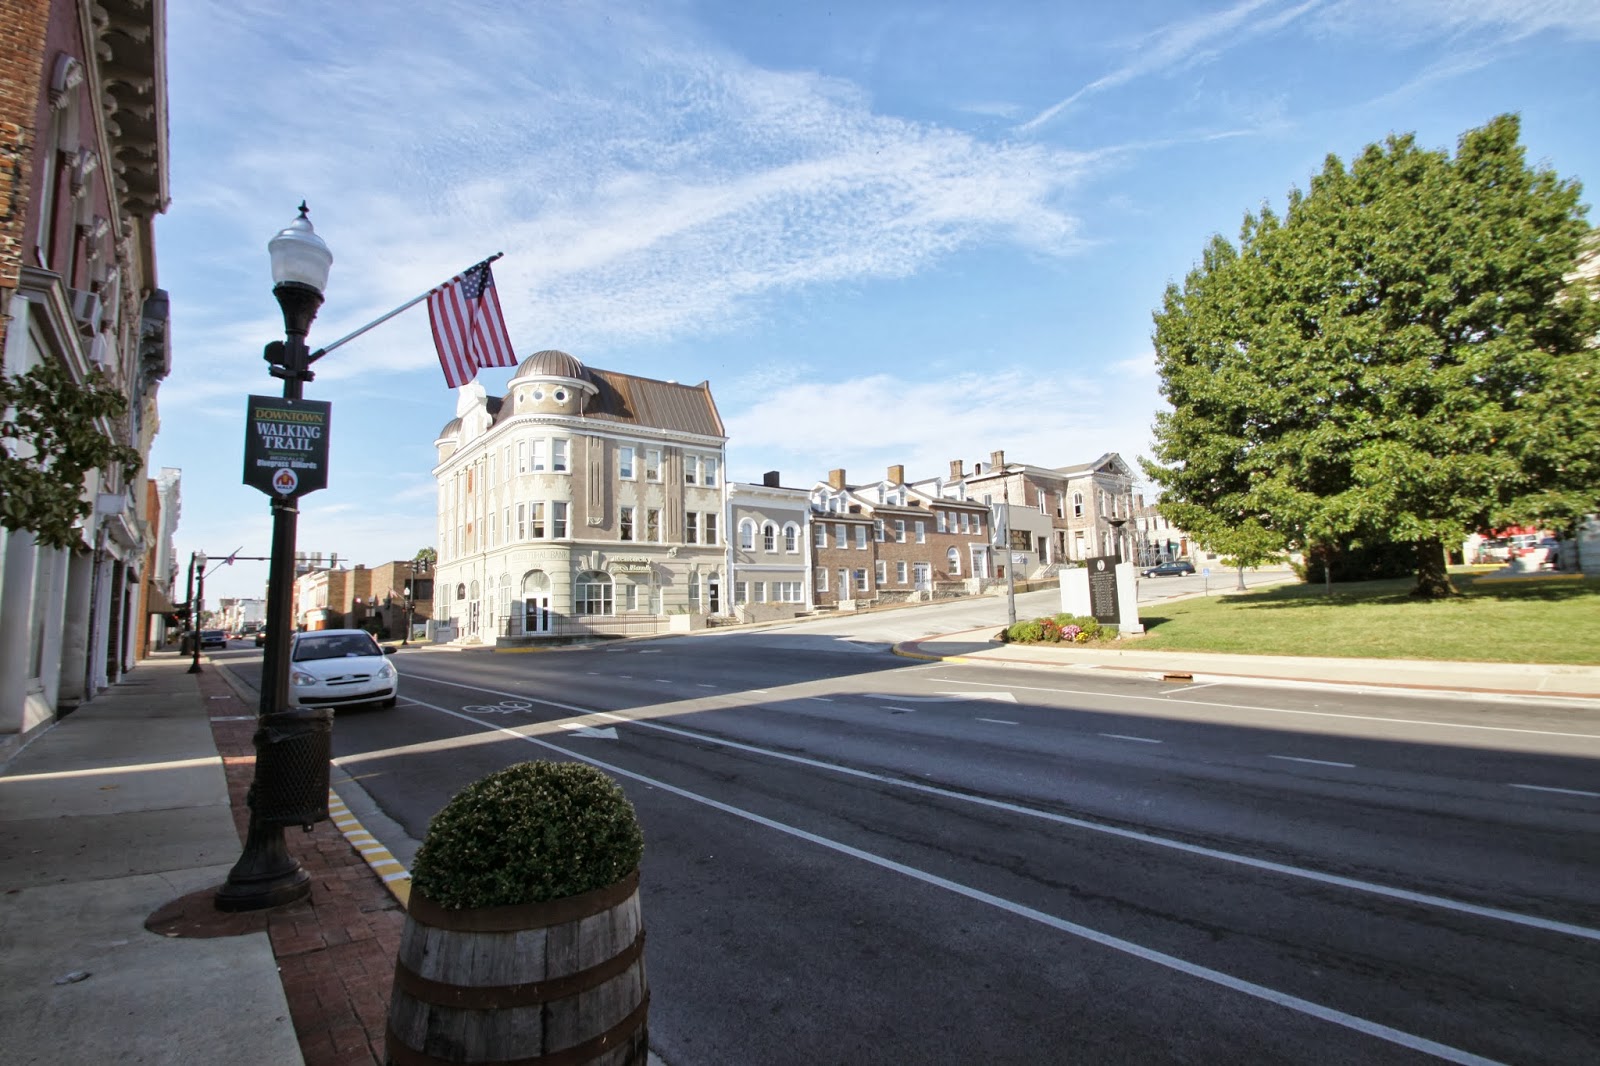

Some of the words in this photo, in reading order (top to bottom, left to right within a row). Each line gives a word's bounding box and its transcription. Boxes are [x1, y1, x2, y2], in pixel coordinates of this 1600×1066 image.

[255, 409, 323, 422] DOWNTOWN
[256, 422, 321, 438] WALKING
[263, 436, 313, 450] TRAIL
[550, 550, 569, 559] BANK
